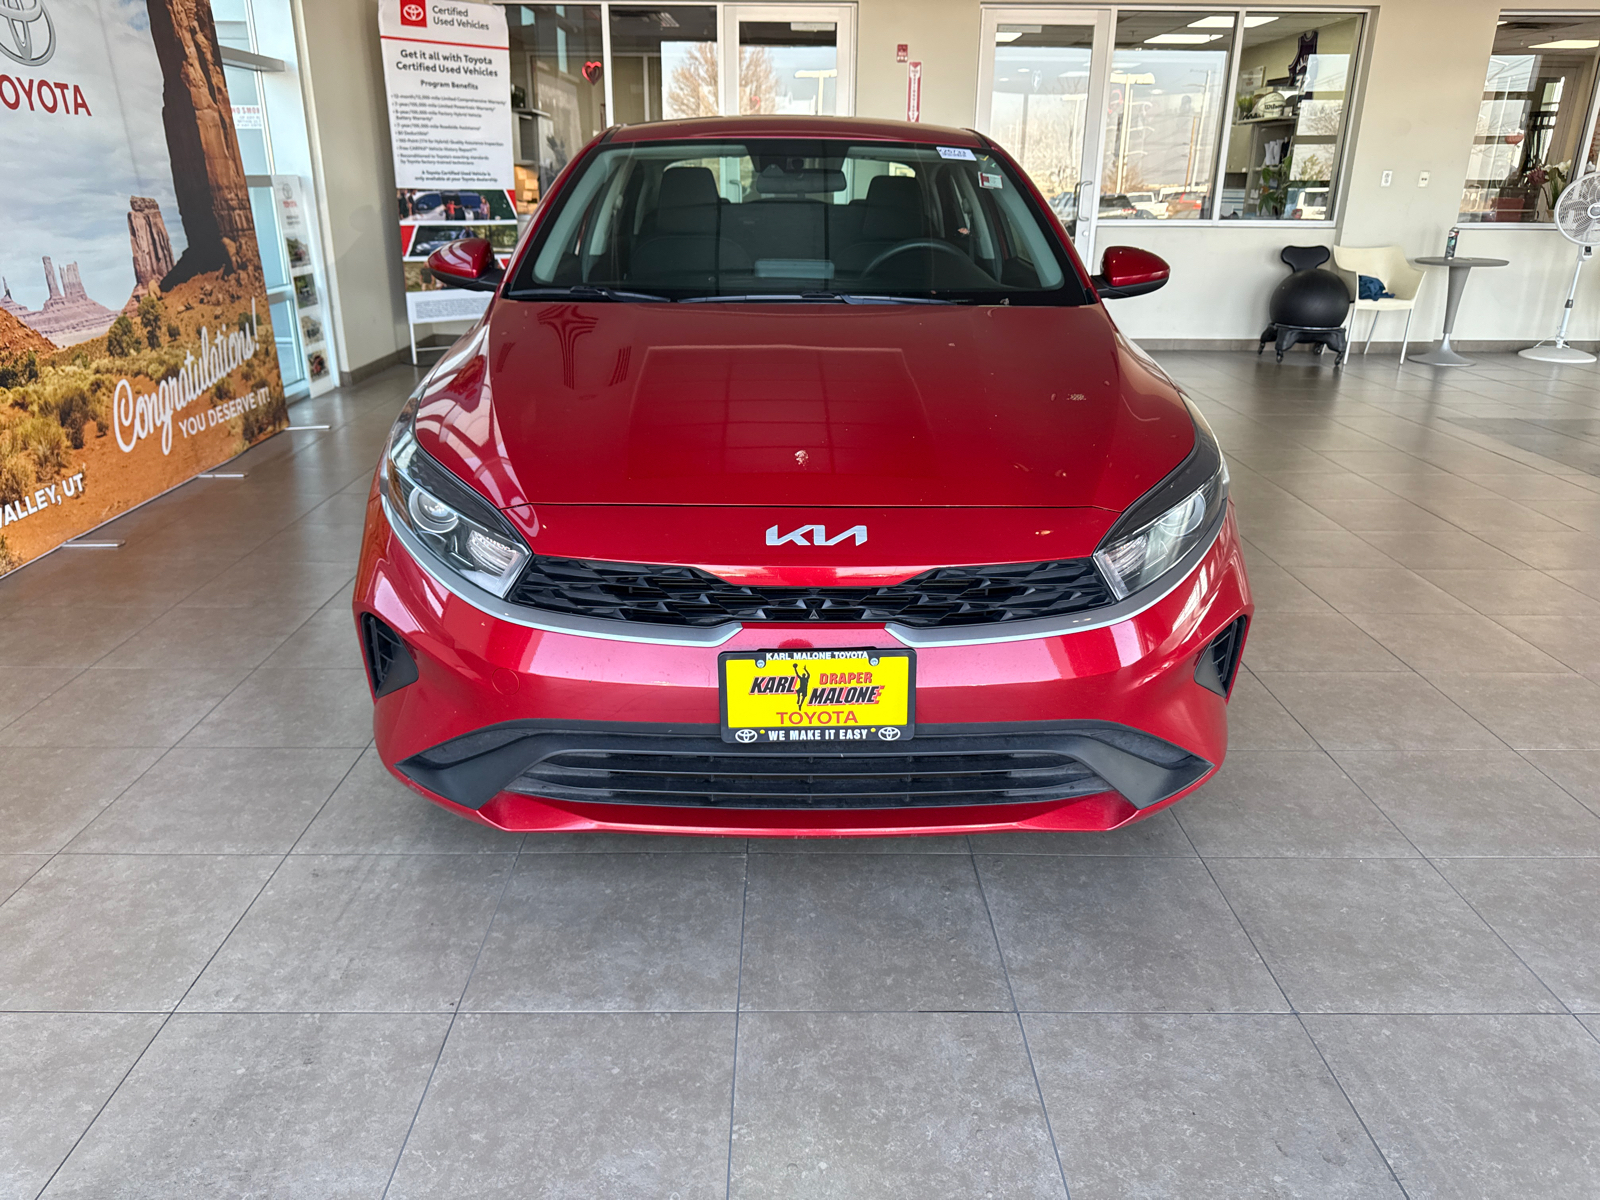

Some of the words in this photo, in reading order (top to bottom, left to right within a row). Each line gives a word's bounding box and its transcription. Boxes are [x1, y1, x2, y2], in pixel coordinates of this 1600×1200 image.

[432, 5, 468, 18] Certified
[433, 16, 454, 26] Used
[456, 18, 490, 30] Vehicles
[400, 49, 418, 59] Get
[420, 50, 426, 60] it
[428, 50, 440, 60] all
[442, 53, 462, 62] with
[464, 54, 492, 66] Toyota
[396, 62, 436, 72] Certified
[438, 64, 460, 74] Used
[462, 66, 498, 77] Vehicles
[420, 80, 450, 88] Program
[452, 82, 478, 90] Benefits
[0, 74, 92, 117] OYOTA
[113, 298, 260, 456] Congratulations!
[178, 411, 206, 438] YOU
[208, 392, 257, 428] DESERVE
[257, 386, 271, 407] IT!
[62, 472, 83, 497] UT
[766, 652, 791, 661] KARL
[794, 652, 832, 660] MALONE
[833, 651, 868, 660] TOYOTA
[819, 672, 872, 685] DRAPER
[749, 676, 798, 695] KARL
[807, 686, 885, 706] MALONE
[776, 711, 858, 725] TOYOTA
[768, 730, 786, 741] WE
[791, 730, 821, 740] MAKE
[825, 729, 835, 740] IT
[839, 729, 868, 739] EASY
